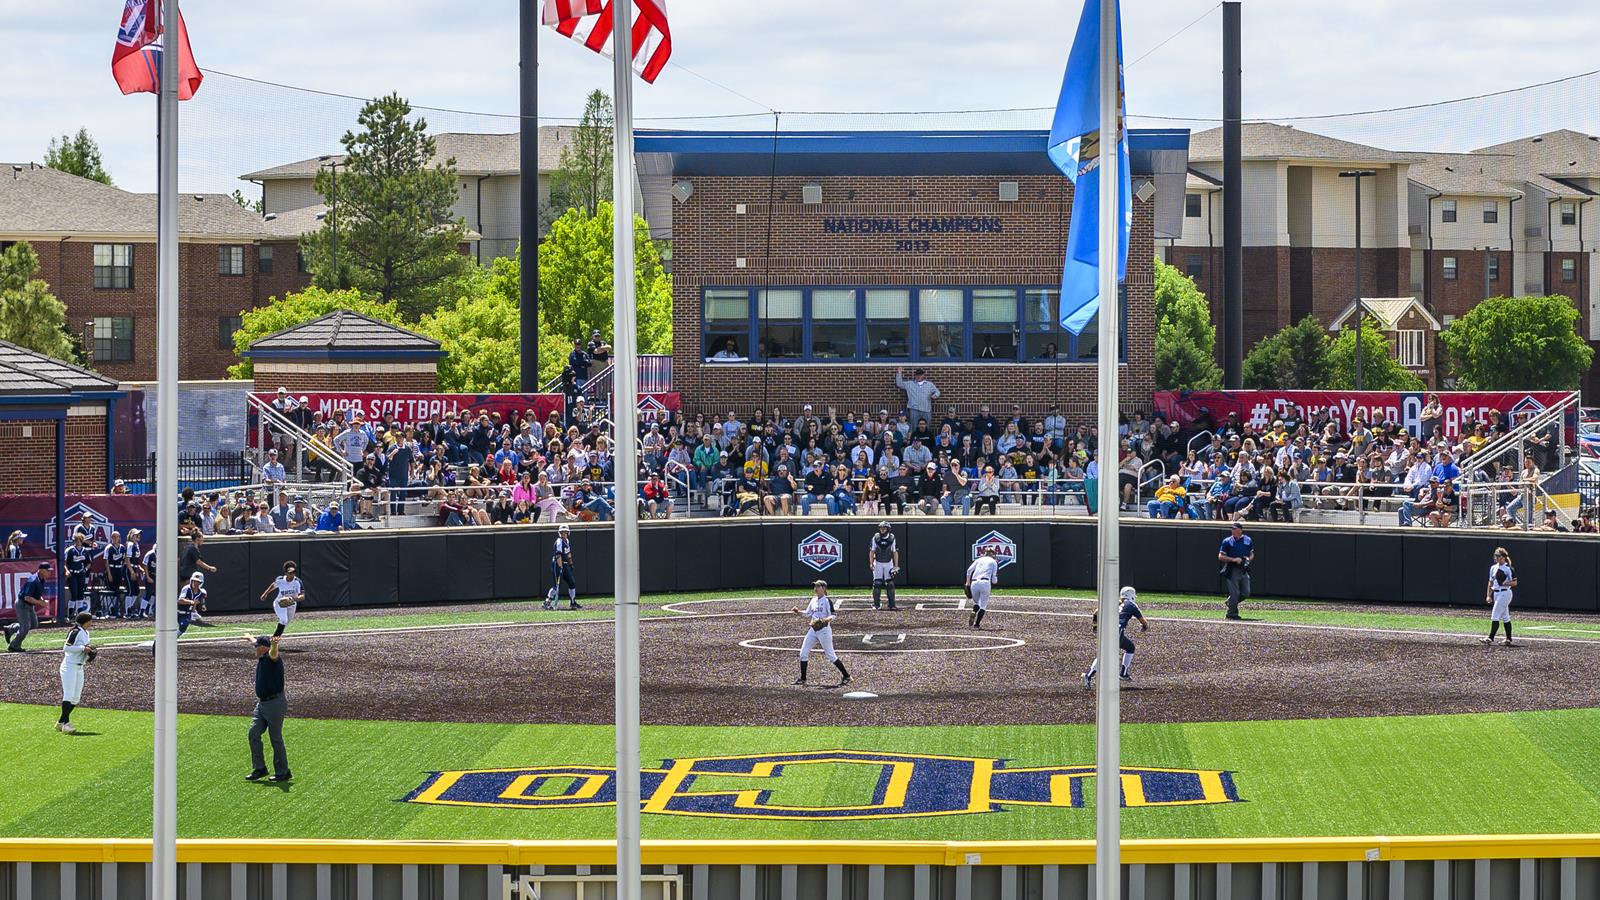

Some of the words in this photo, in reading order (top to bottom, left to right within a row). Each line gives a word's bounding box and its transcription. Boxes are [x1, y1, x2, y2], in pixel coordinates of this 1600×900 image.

[823, 218, 901, 233] NATIONAL
[908, 217, 1002, 233] CHAMPIONS
[370, 399, 460, 420] SOFTBALL
[803, 544, 838, 556] MIAA
[976, 544, 1012, 556] MAA
